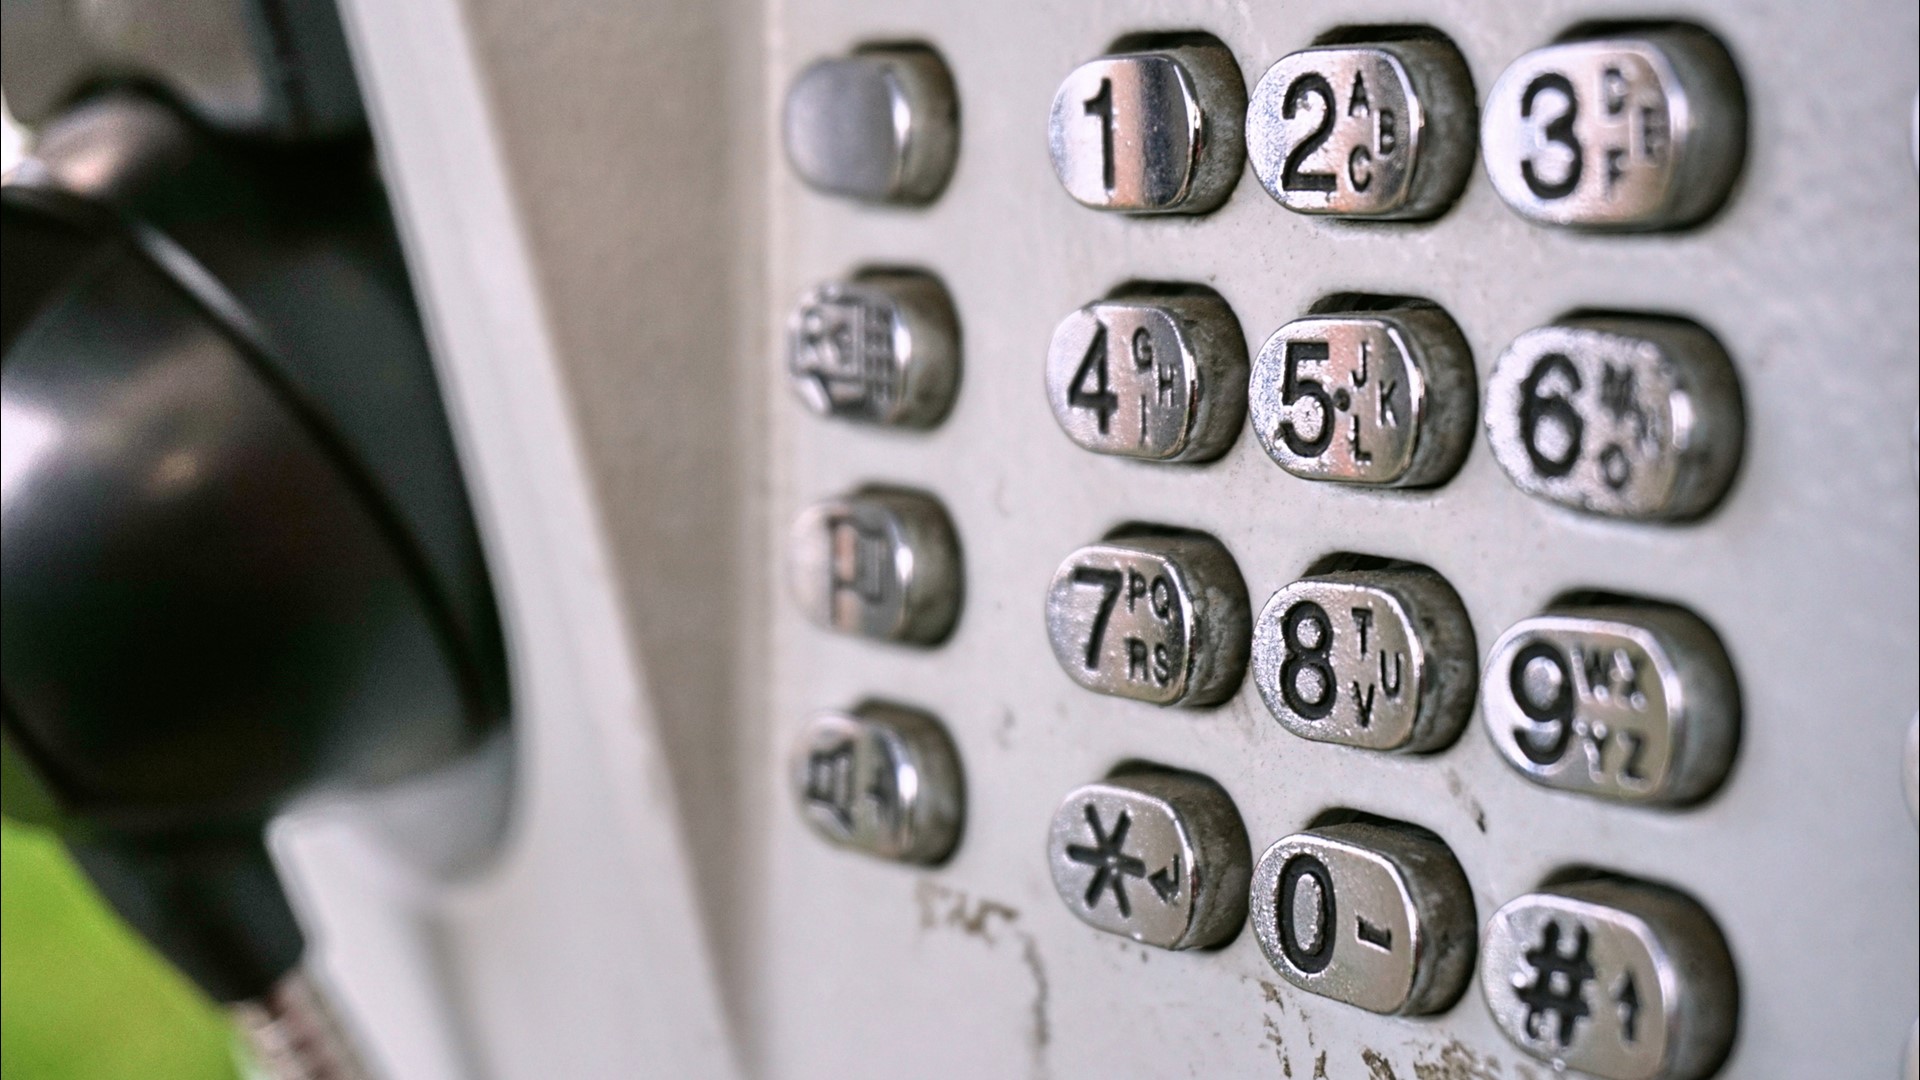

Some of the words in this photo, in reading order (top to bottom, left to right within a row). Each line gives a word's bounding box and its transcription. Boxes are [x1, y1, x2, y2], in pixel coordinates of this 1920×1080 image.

[1083, 78, 1115, 190] 1
[1281, 72, 1337, 191] 2
[1348, 69, 1370, 118] A
[1521, 73, 1582, 200] 3
[1348, 144, 1371, 193] C
[1067, 320, 1119, 435] 4
[1132, 326, 1153, 370] G
[1280, 341, 1334, 458] 5
[1519, 353, 1582, 479] 6
[1071, 565, 1124, 670] 7
[1280, 600, 1337, 721] 8
[1351, 607, 1373, 661] T
[1352, 681, 1376, 729] V
[1380, 649, 1403, 700] U
[1510, 640, 1573, 767] 9
